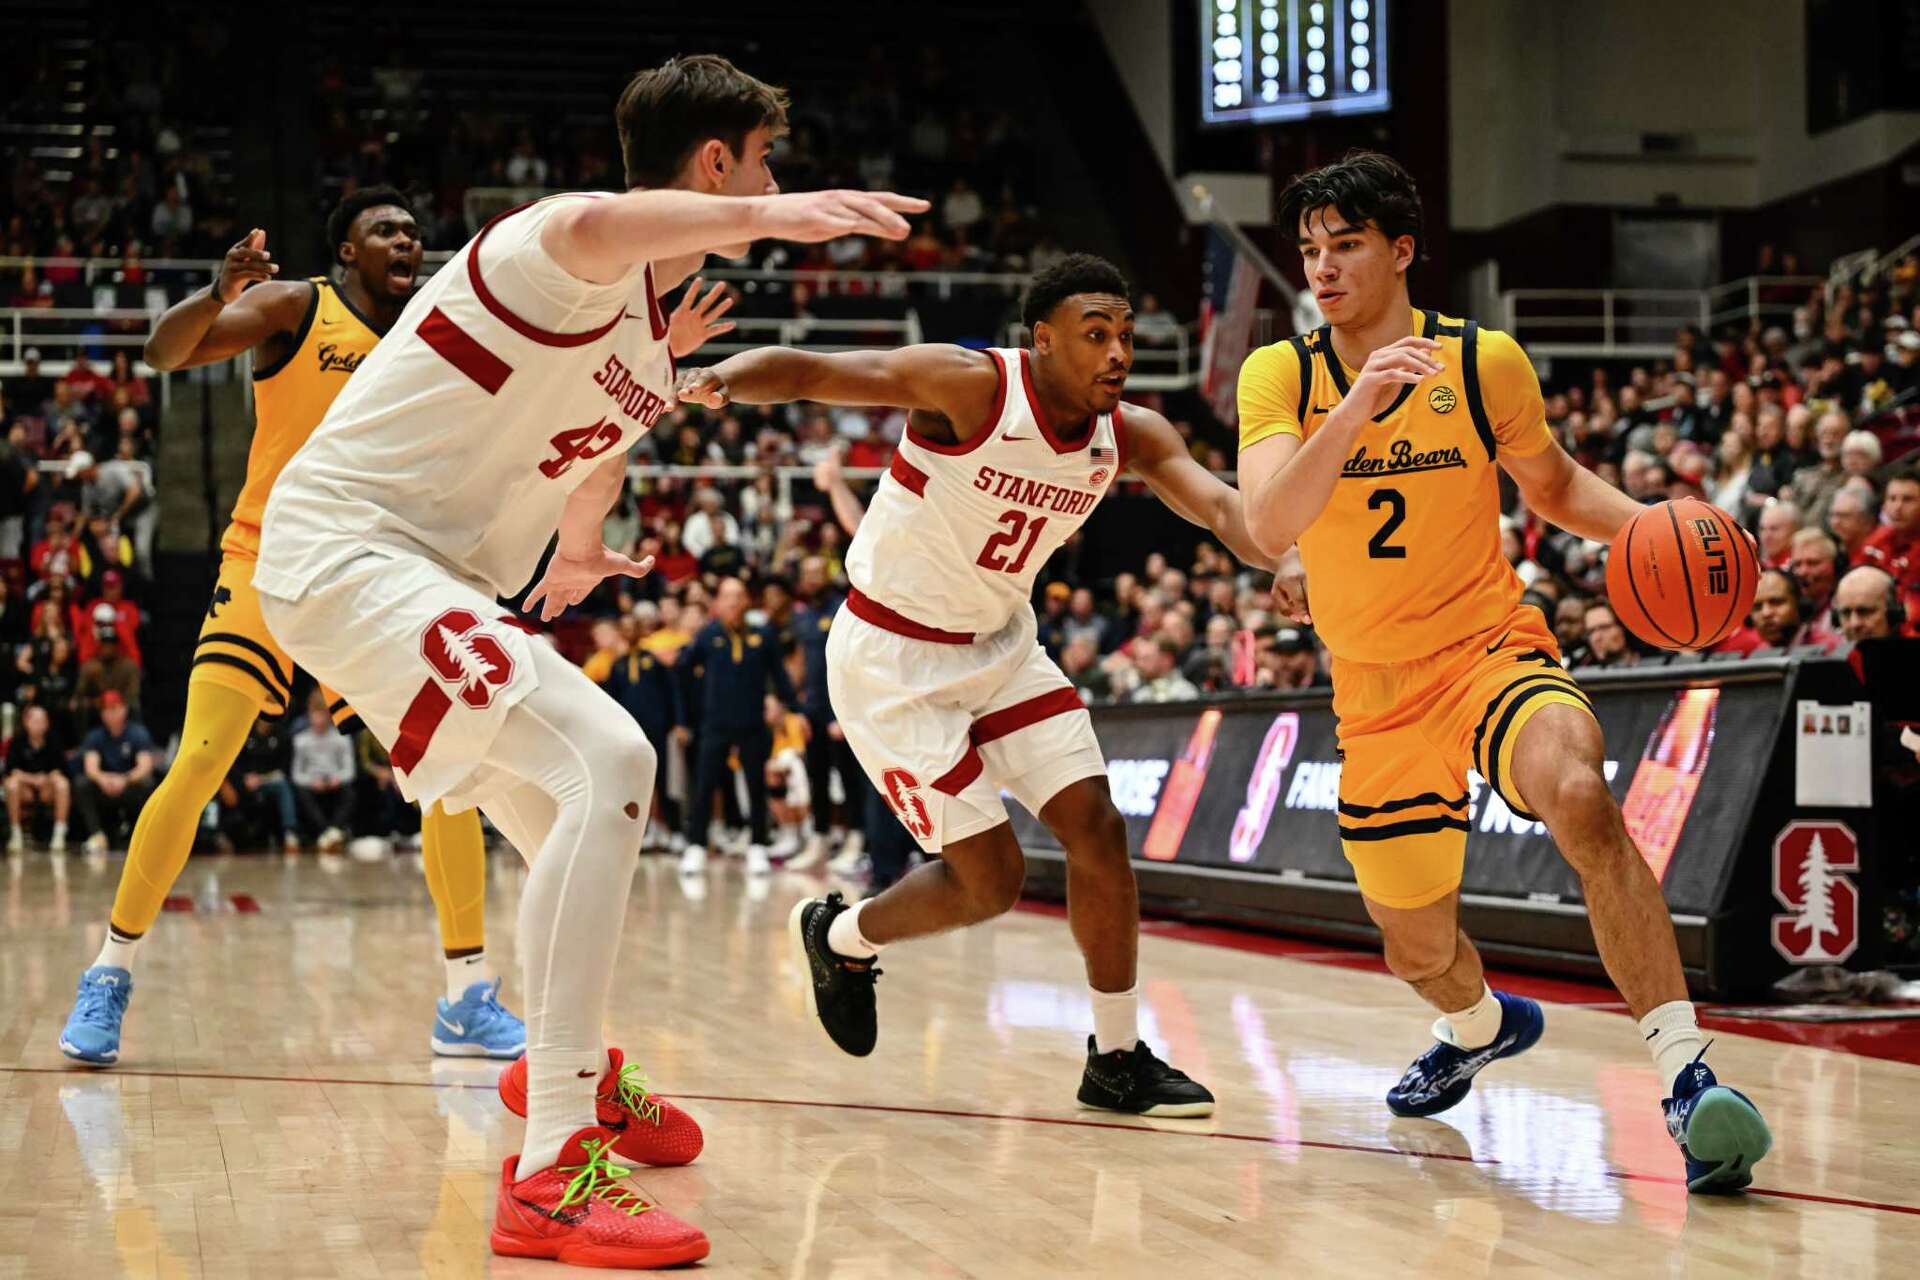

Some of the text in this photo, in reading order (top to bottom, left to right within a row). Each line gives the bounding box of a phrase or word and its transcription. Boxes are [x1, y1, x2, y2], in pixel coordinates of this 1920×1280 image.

[318, 342, 366, 373] Gold
[1432, 393, 1454, 402] ACC
[1342, 439, 1467, 473] den Bears
[973, 465, 1097, 516] STANFORD
[975, 508, 1049, 574] 21
[1367, 488, 1407, 559] 2
[1695, 518, 1728, 595] ELITE
